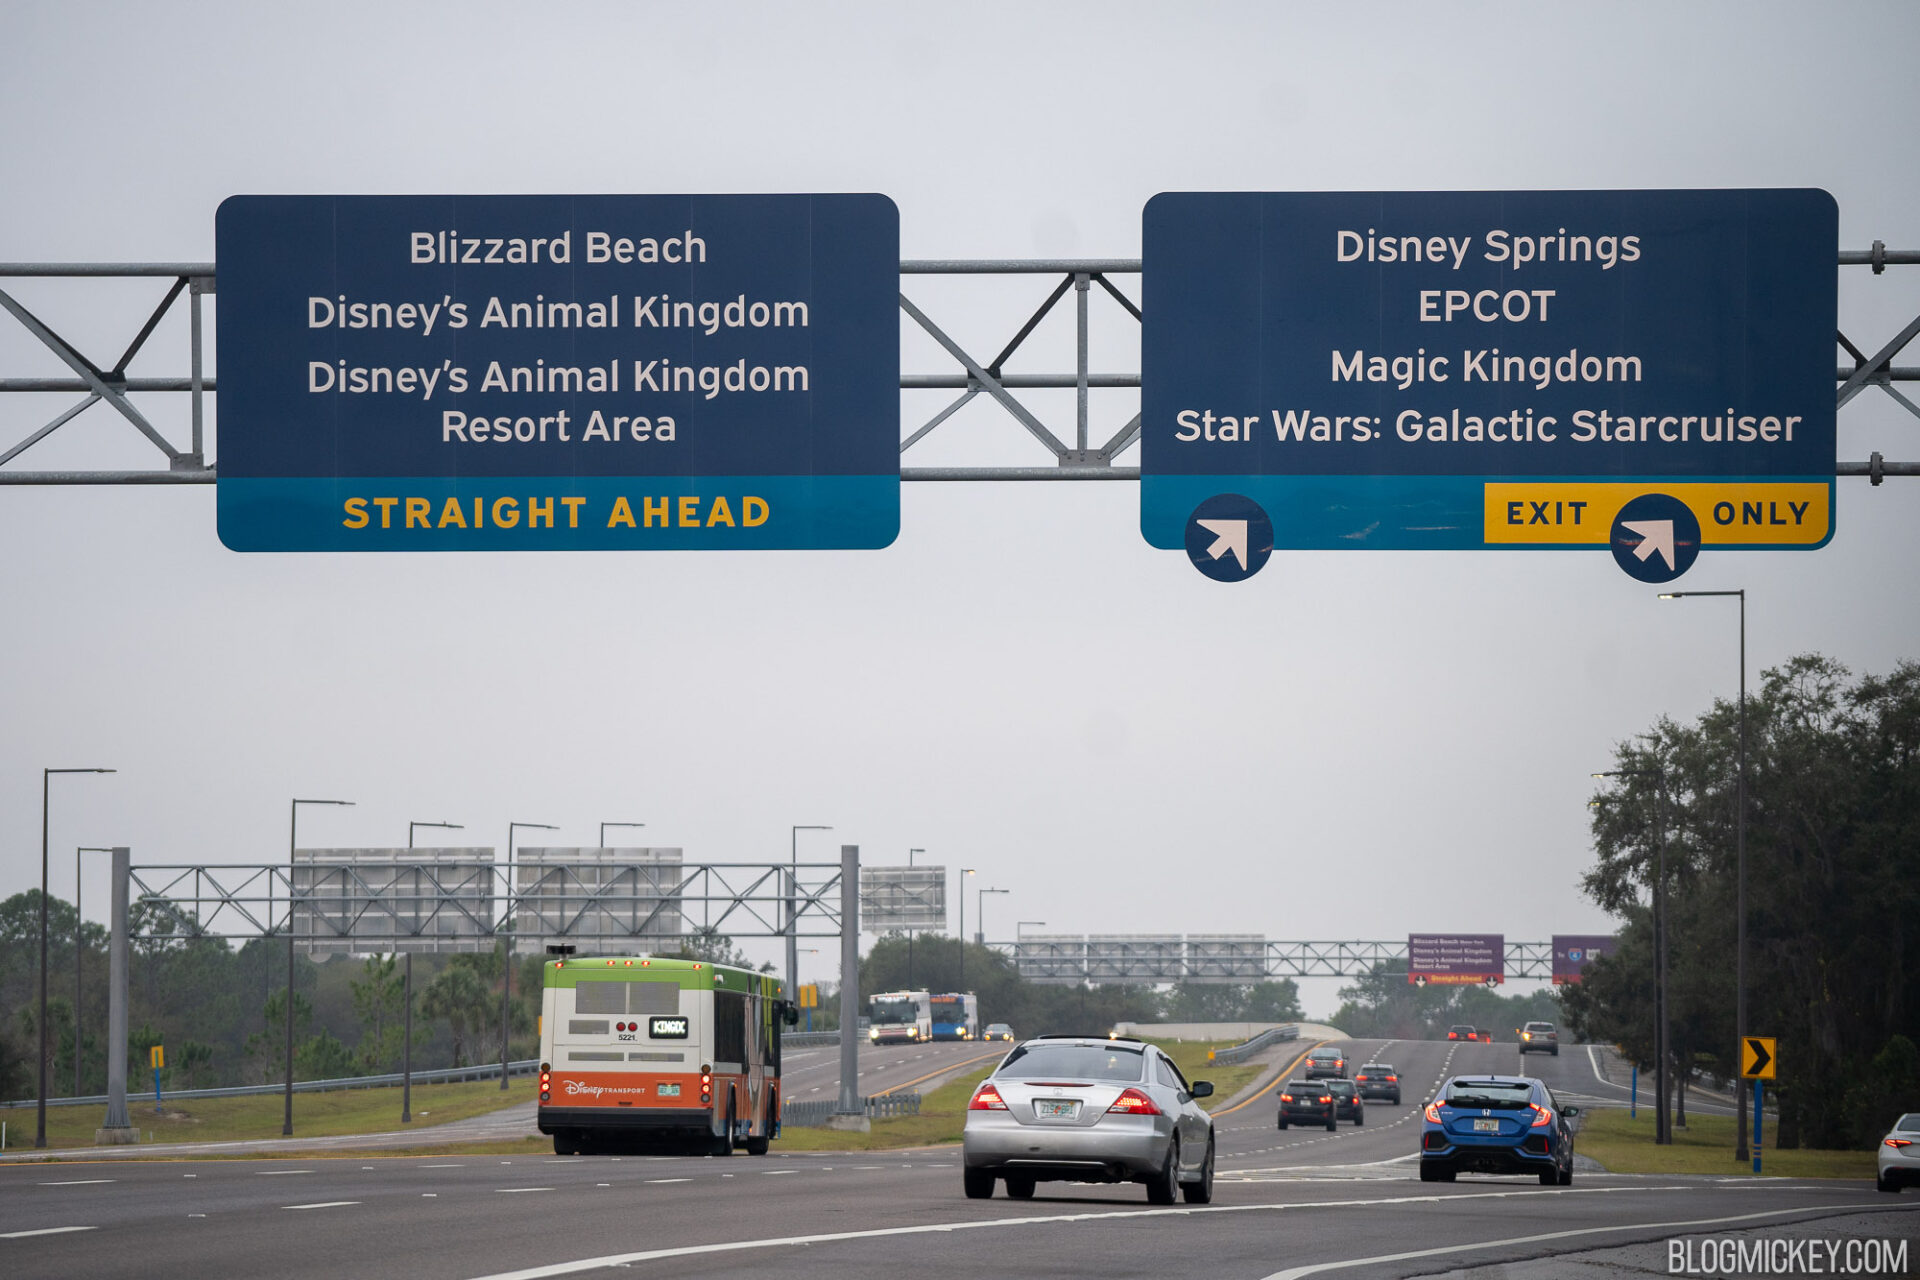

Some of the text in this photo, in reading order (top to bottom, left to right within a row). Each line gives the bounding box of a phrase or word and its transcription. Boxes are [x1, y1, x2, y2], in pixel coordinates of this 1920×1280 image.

[411, 229, 706, 264] Blizzard Beach
[1337, 227, 1641, 271] Disney Springs
[308, 293, 809, 336] Disney's Animal Kingdom
[1420, 289, 1556, 323] EPCOT
[309, 358, 809, 401] Disney's Animal Kingdom
[1332, 347, 1642, 391] Magic Kingdom
[442, 409, 676, 443] Resort Area
[1174, 407, 1802, 443] Star Wars: Galactic Starcruiser
[343, 496, 770, 529] STRAIGHT AHEAD
[1507, 501, 1810, 526] EXIT ONLY
[563, 1080, 603, 1099] Disney
